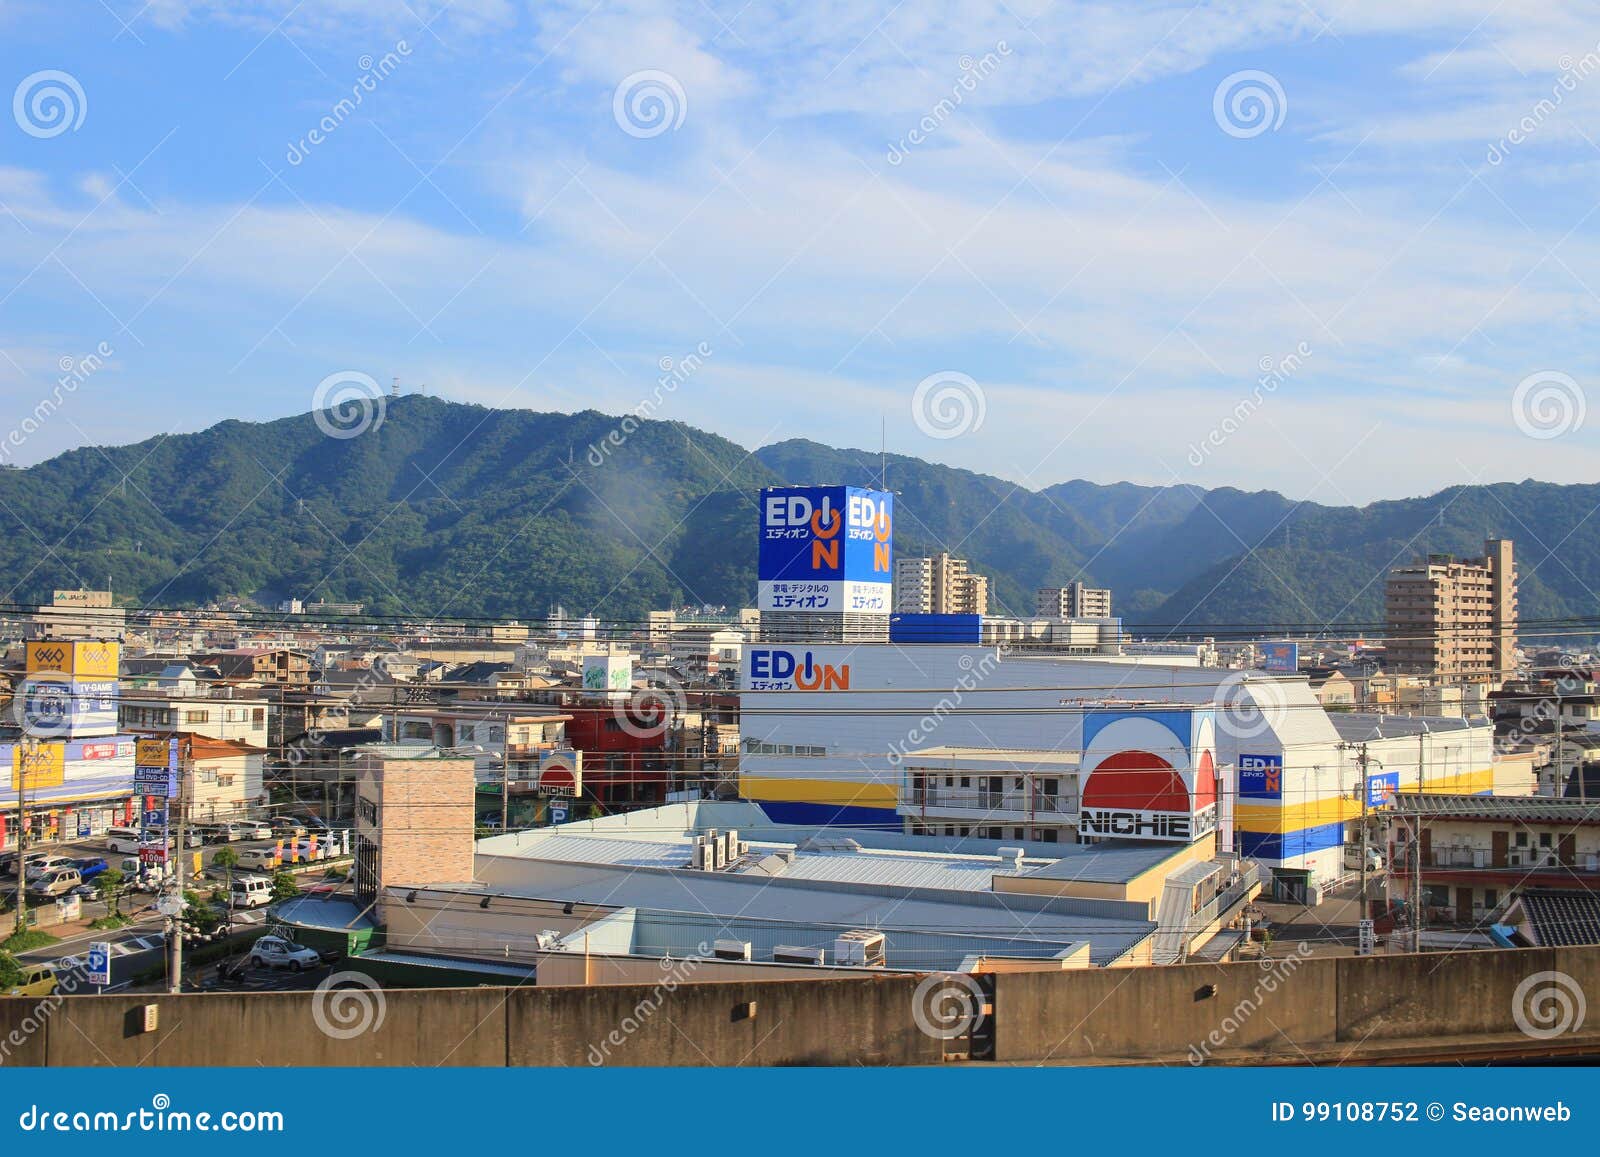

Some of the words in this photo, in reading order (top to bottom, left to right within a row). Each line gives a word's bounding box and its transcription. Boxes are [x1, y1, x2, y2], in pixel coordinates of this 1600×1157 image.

[766, 528, 809, 539] エディオン
[772, 595, 829, 608] エディオン
[751, 651, 850, 691] EDION
[750, 681, 793, 691] エディオン
[150, 811, 159, 823] P
[552, 809, 566, 824] P
[1081, 811, 1191, 838] NICHIE
